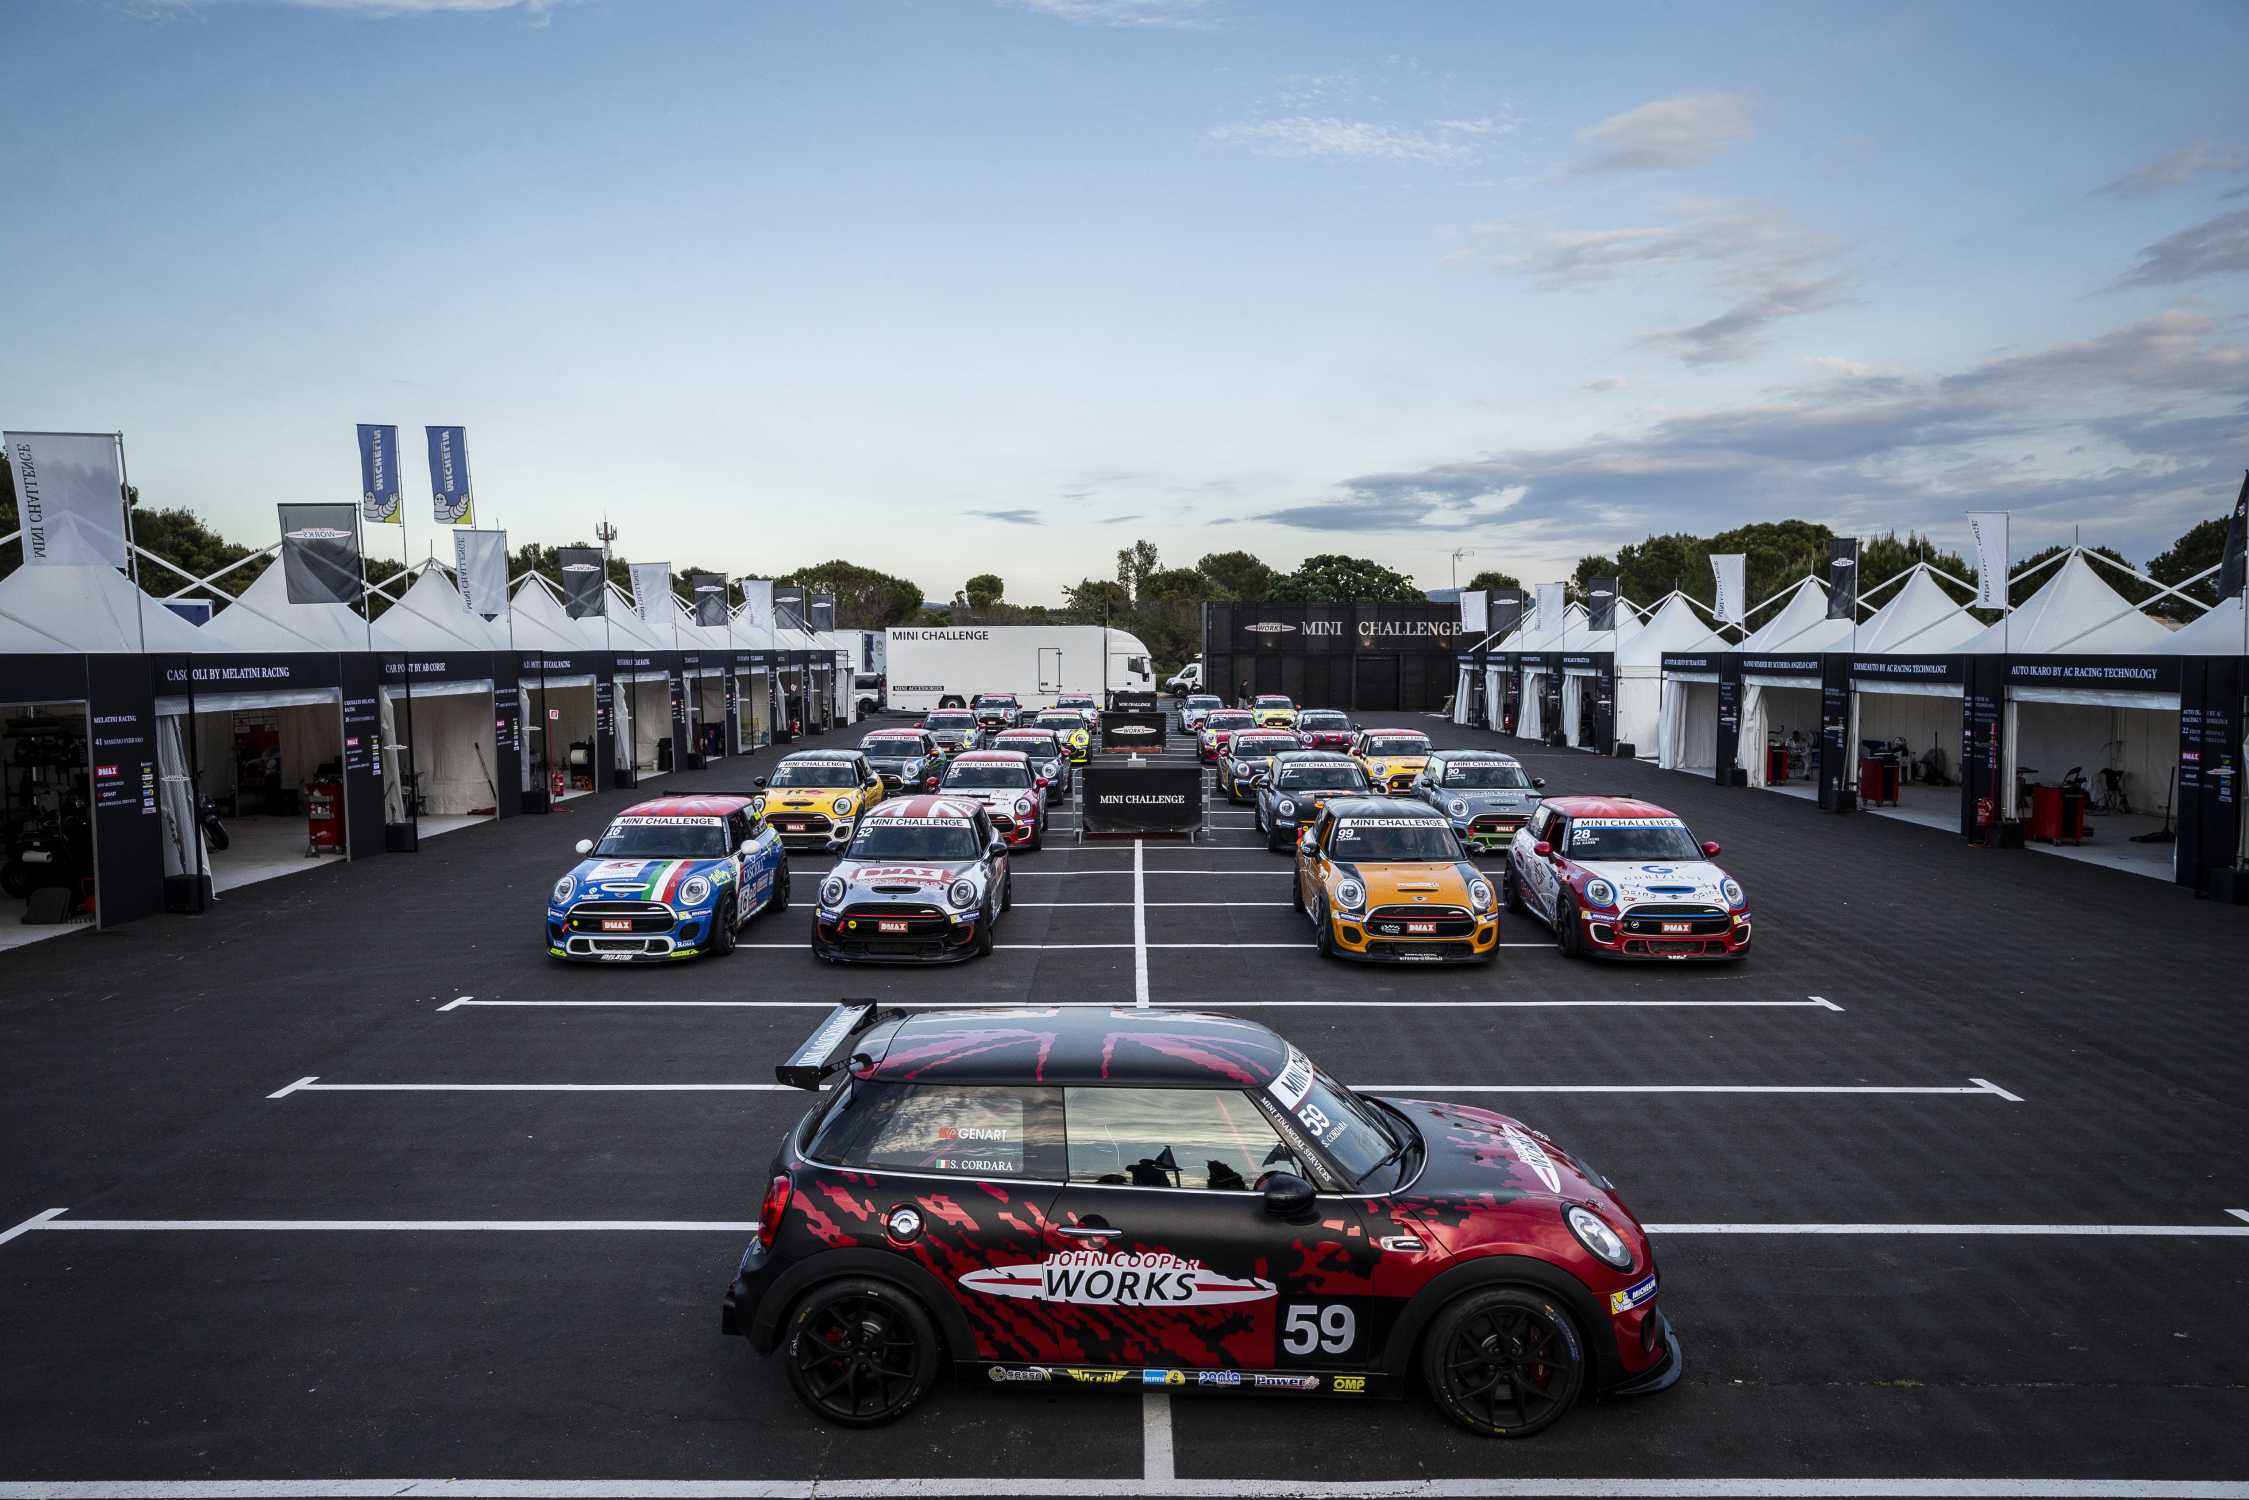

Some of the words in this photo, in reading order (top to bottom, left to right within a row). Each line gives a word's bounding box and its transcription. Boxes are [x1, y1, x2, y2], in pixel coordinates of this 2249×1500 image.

[1301, 622, 1342, 636] MINI
[1359, 622, 1463, 636] CHALLENGE
[892, 631, 919, 641] MINI
[921, 630, 989, 641] CHALLENGE
[209, 668, 221, 680] BY
[222, 667, 260, 679] MELATINI
[261, 666, 290, 678] RACING
[1913, 665, 1947, 673] TECHNOLOGY
[2012, 666, 2029, 675] AUTO
[2030, 666, 2051, 676] IKARO
[2053, 667, 2062, 676] BY
[2063, 667, 2074, 677] AC
[2074, 667, 2102, 678] RACING
[2103, 668, 2158, 679] TECHNOLOGY
[1100, 795, 1124, 804] MINI
[1126, 795, 1185, 804] CHALLENGE
[621, 817, 644, 825] MINI
[646, 817, 715, 825] CHALLENGE
[870, 818, 893, 826] MINI
[896, 818, 963, 826] CHALLENGE
[1351, 819, 1374, 827] MINI
[1378, 819, 1443, 827] CHALLENGE
[857, 828, 873, 838] 52
[1338, 829, 1354, 839] 99
[1573, 830, 1590, 839] 28
[865, 868, 933, 877] DMAX
[604, 921, 630, 929] DMAX
[881, 923, 906, 931] DMAX
[1409, 924, 1434, 932] DMAX
[1281, 1066, 1309, 1098] MINI
[1297, 1103, 1330, 1137] 59
[958, 1128, 1008, 1140] GENART
[1261, 1097, 1275, 1115] MINI
[1274, 1112, 1305, 1150] FINANCIAL
[1303, 1148, 1332, 1182] SERVICES
[950, 1160, 959, 1169] S.
[961, 1160, 1013, 1171] CORDARA
[1046, 1251, 1109, 1266] JOHN
[1115, 1251, 1200, 1271] COOPER
[1046, 1268, 1196, 1301] WORKS
[1283, 1305, 1356, 1355] 59
[1333, 1379, 1365, 1390] OMP
